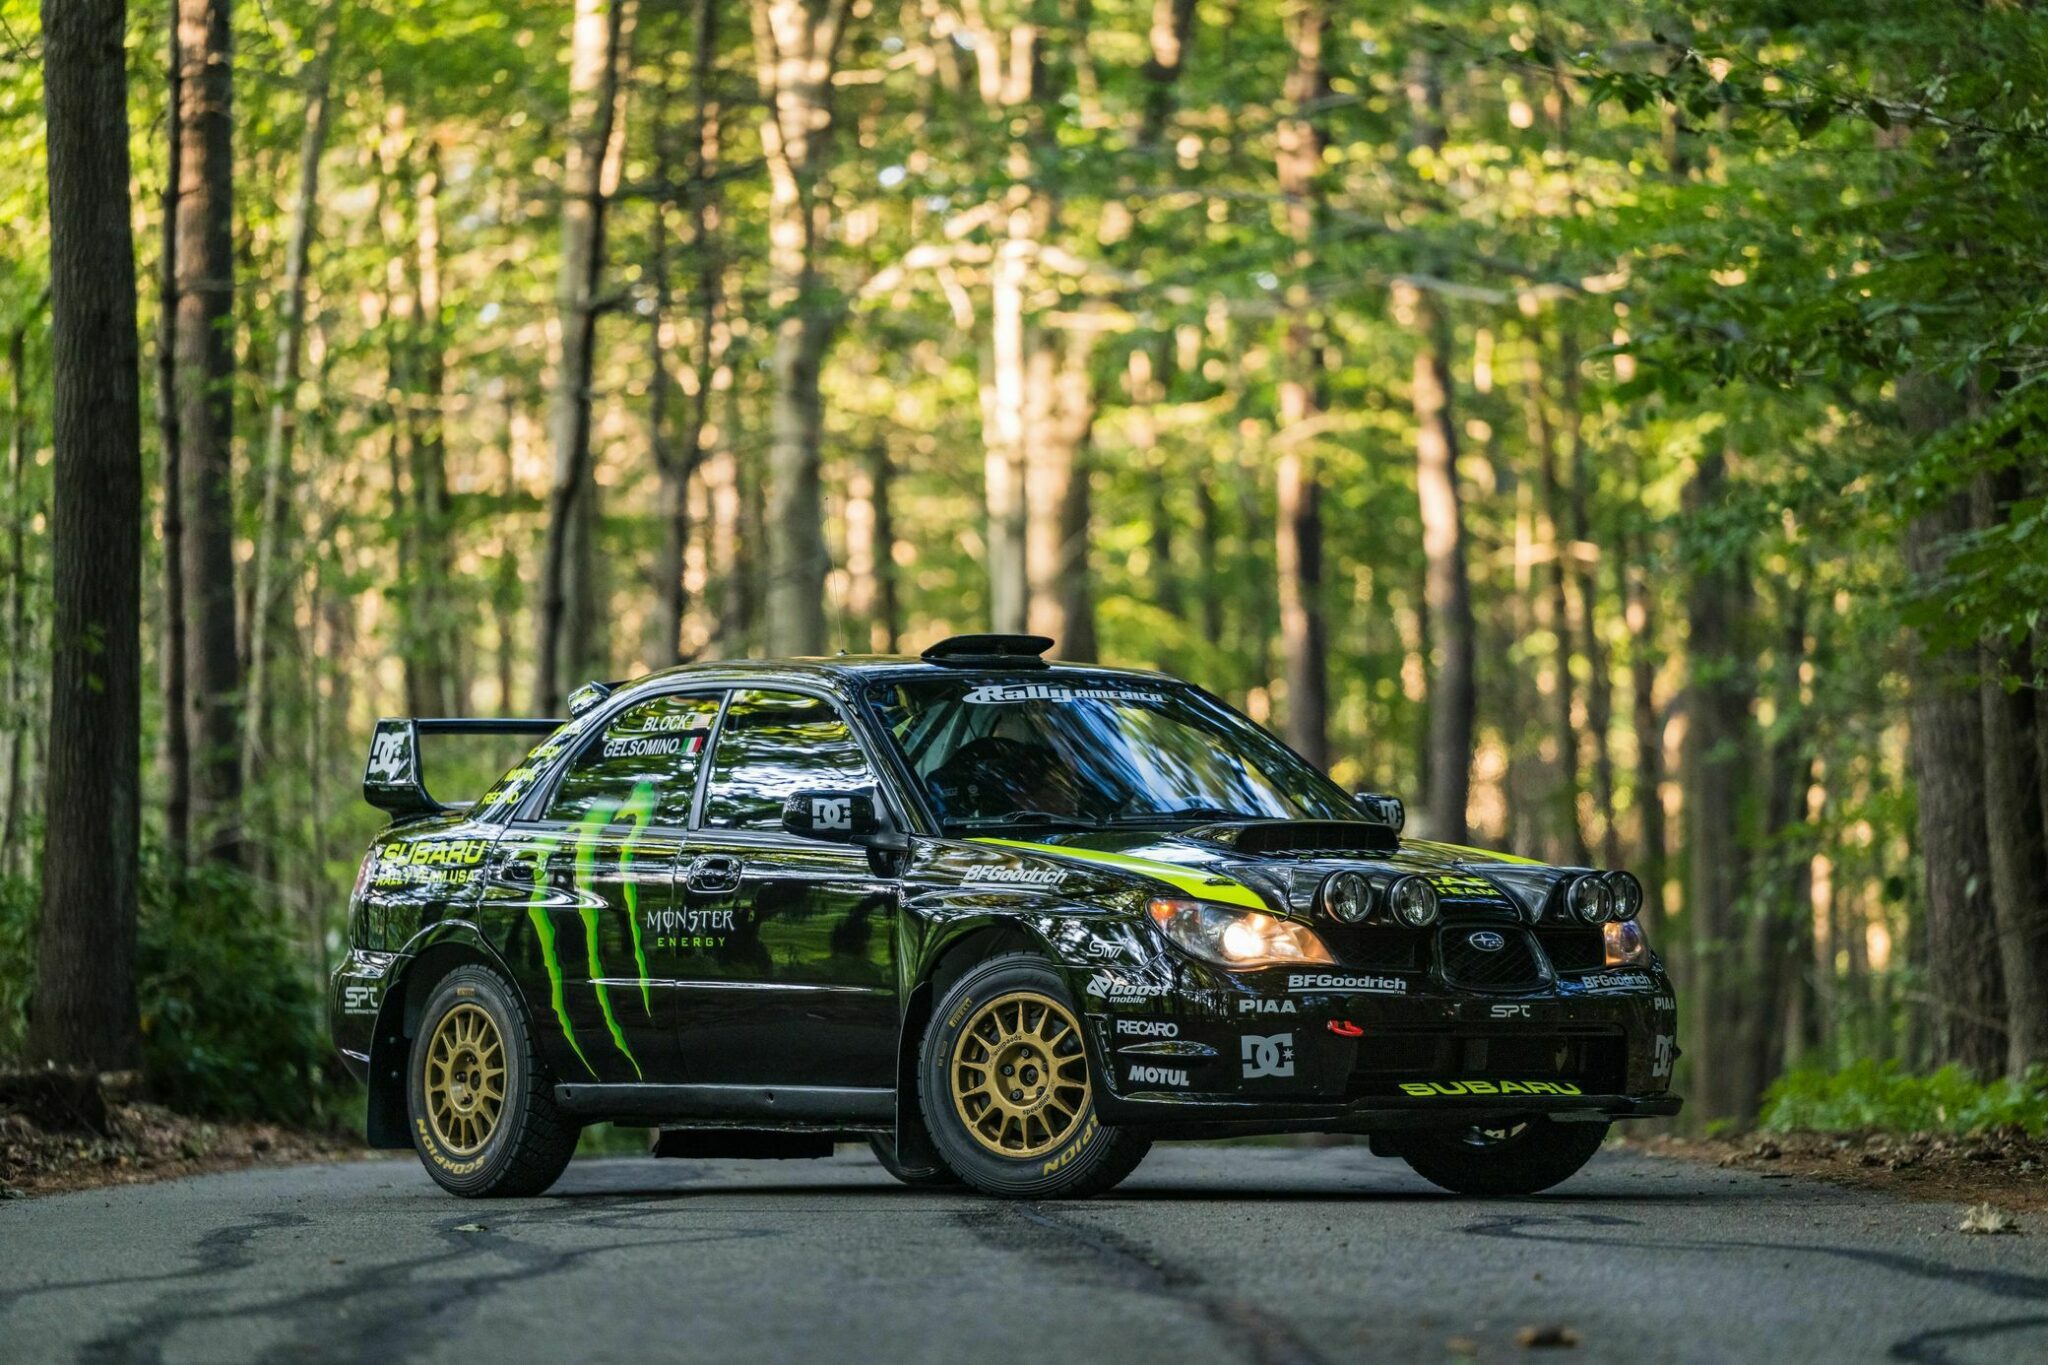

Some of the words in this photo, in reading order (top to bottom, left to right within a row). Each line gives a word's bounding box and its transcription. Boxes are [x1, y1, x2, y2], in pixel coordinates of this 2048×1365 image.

[962, 683, 1073, 704] Rally
[642, 715, 688, 732] BLOCK
[603, 738, 680, 758] GELSOMINO
[811, 798, 852, 830] DC
[382, 840, 488, 865] SUBARU
[450, 868, 475, 883] USA
[963, 864, 1069, 884] BFGoodrich
[647, 905, 736, 935] MONSTER
[657, 936, 726, 948] ENERGY
[1109, 981, 1174, 997] boost
[1288, 974, 1407, 990] BFGoodrich
[1581, 974, 1652, 990] BFGoodrich
[1108, 995, 1147, 1004] mobile
[1239, 999, 1297, 1014] PIAA
[1116, 1019, 1179, 1038] RECARO
[1240, 1032, 1296, 1080] DC
[1128, 1065, 1190, 1087] MOTUL
[1399, 1080, 1582, 1096] SUBARU
[416, 1118, 486, 1175] SCORPION
